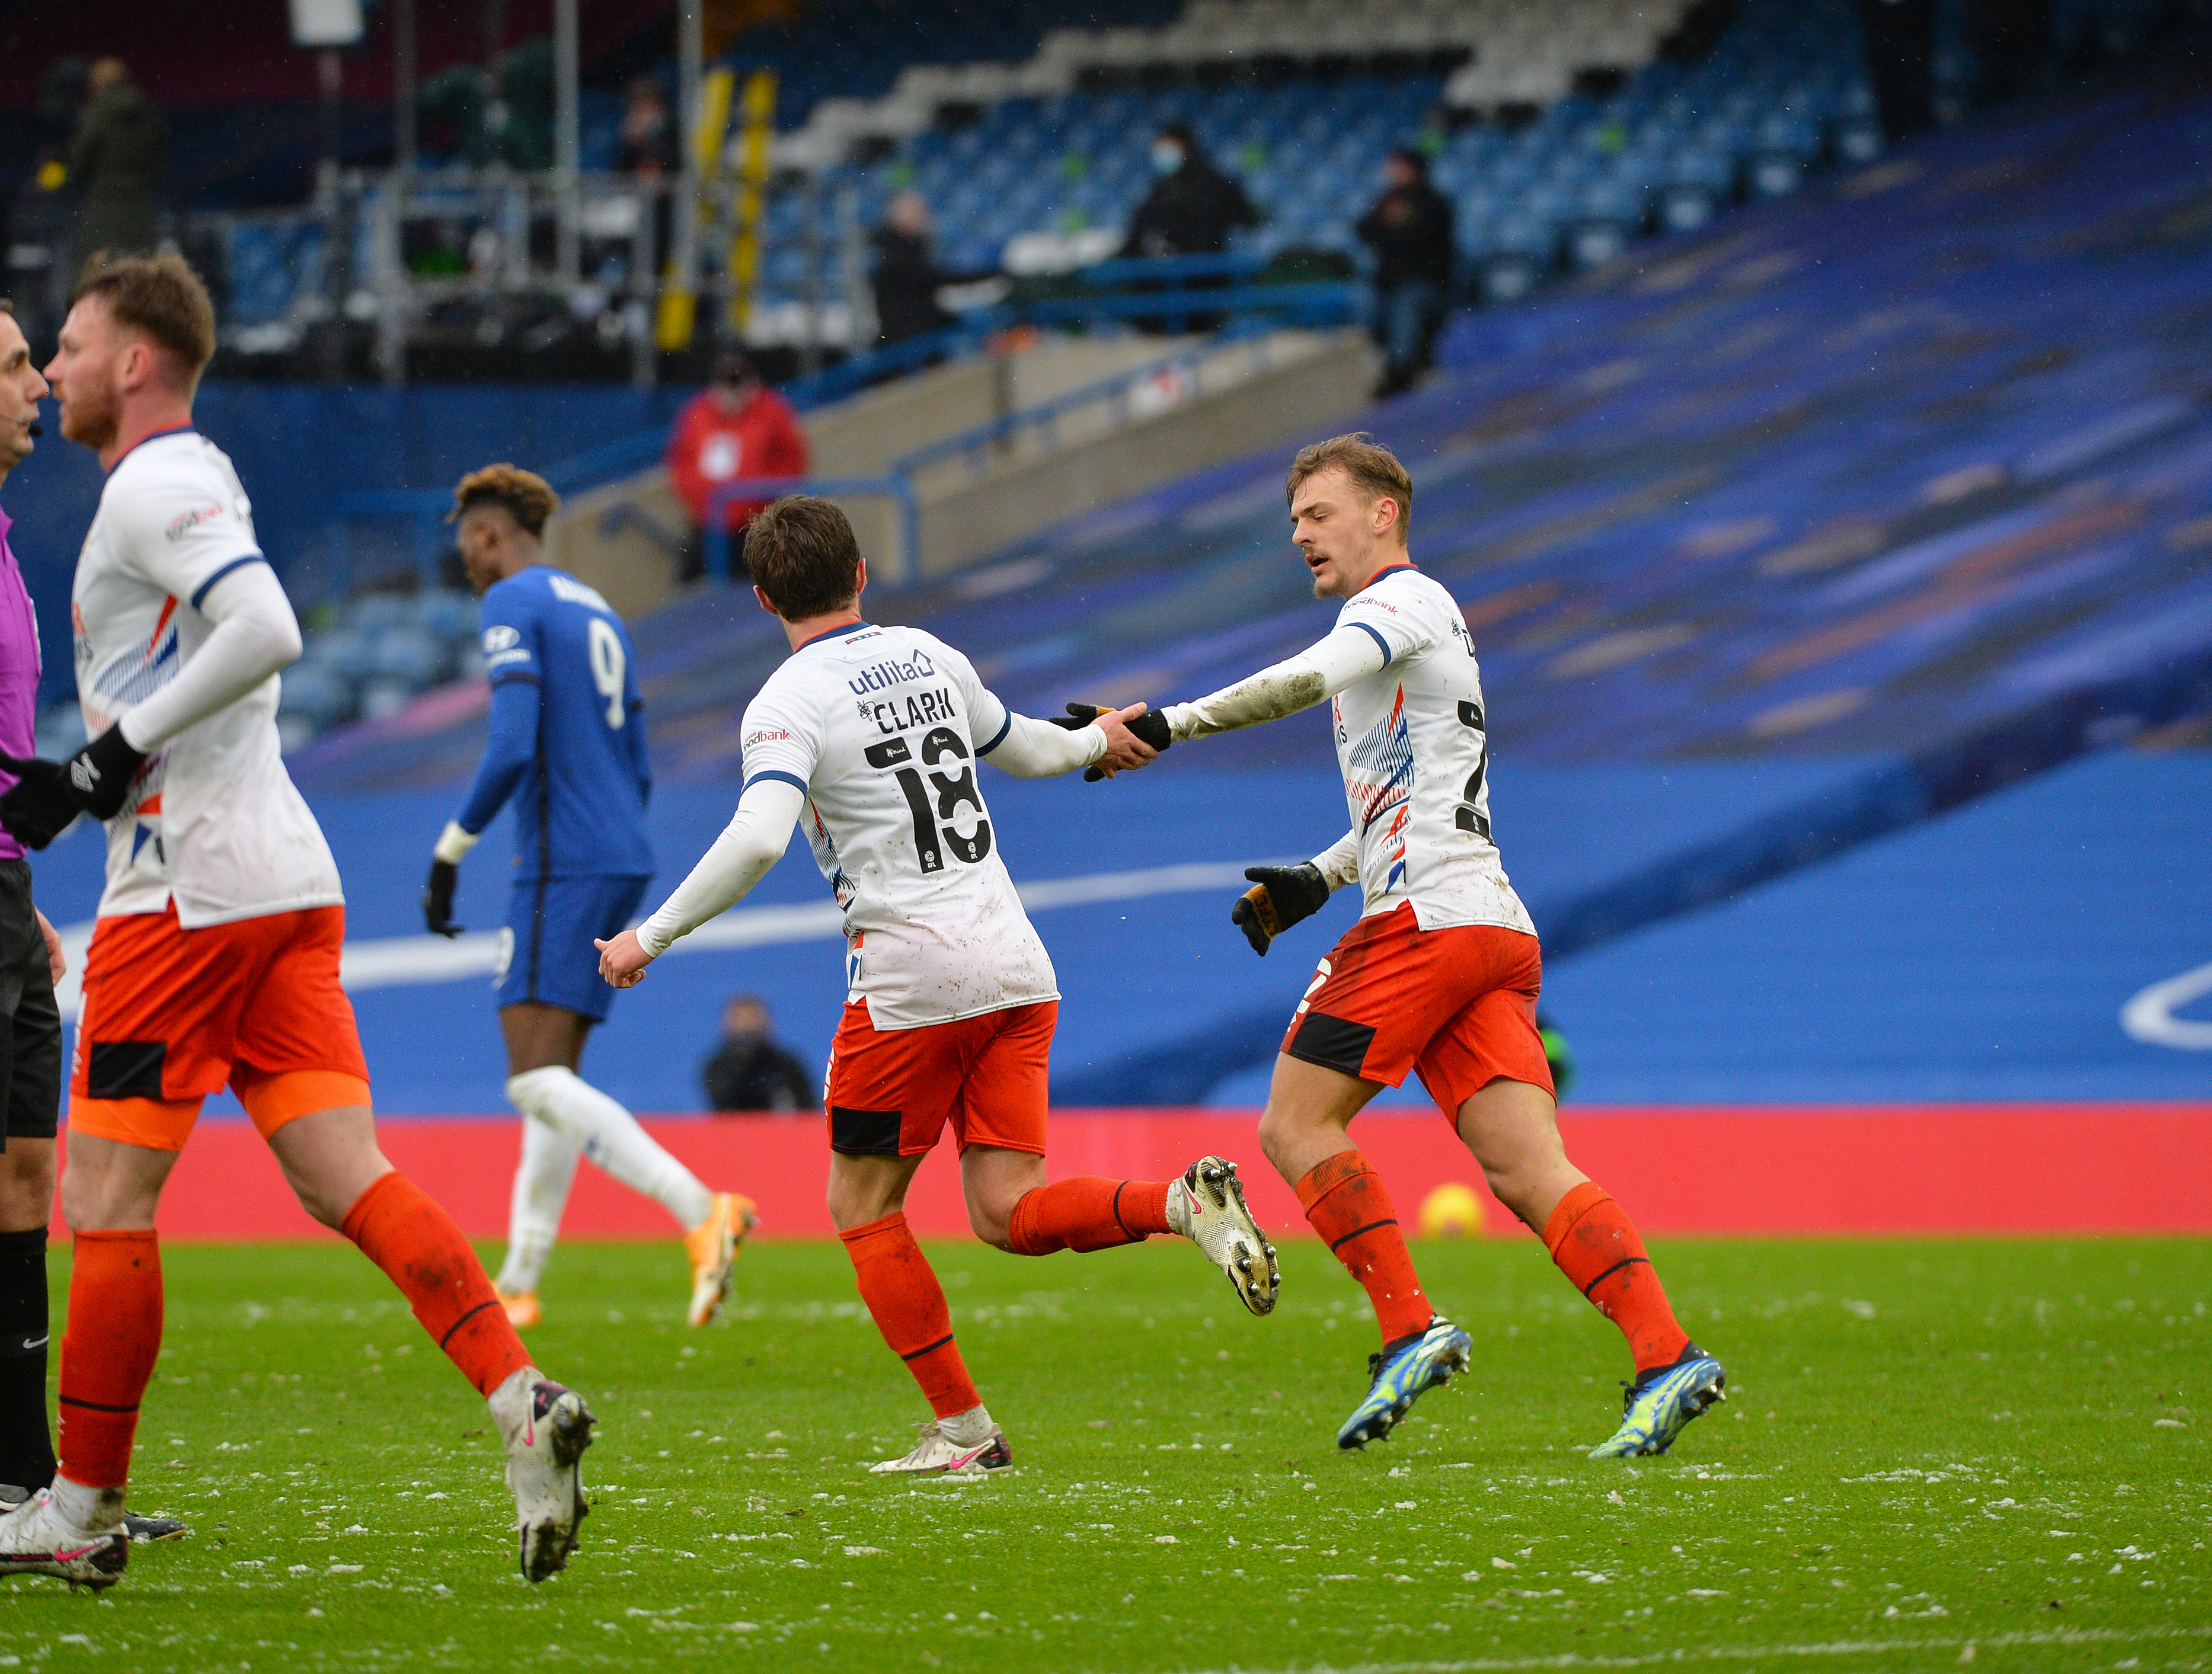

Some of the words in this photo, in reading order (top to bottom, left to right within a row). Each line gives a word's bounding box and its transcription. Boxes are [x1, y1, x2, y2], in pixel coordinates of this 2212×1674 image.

[589, 617, 625, 730] 9
[848, 660, 919, 695] utilita
[874, 687, 955, 734] CLARK
[864, 726, 991, 874] 18
